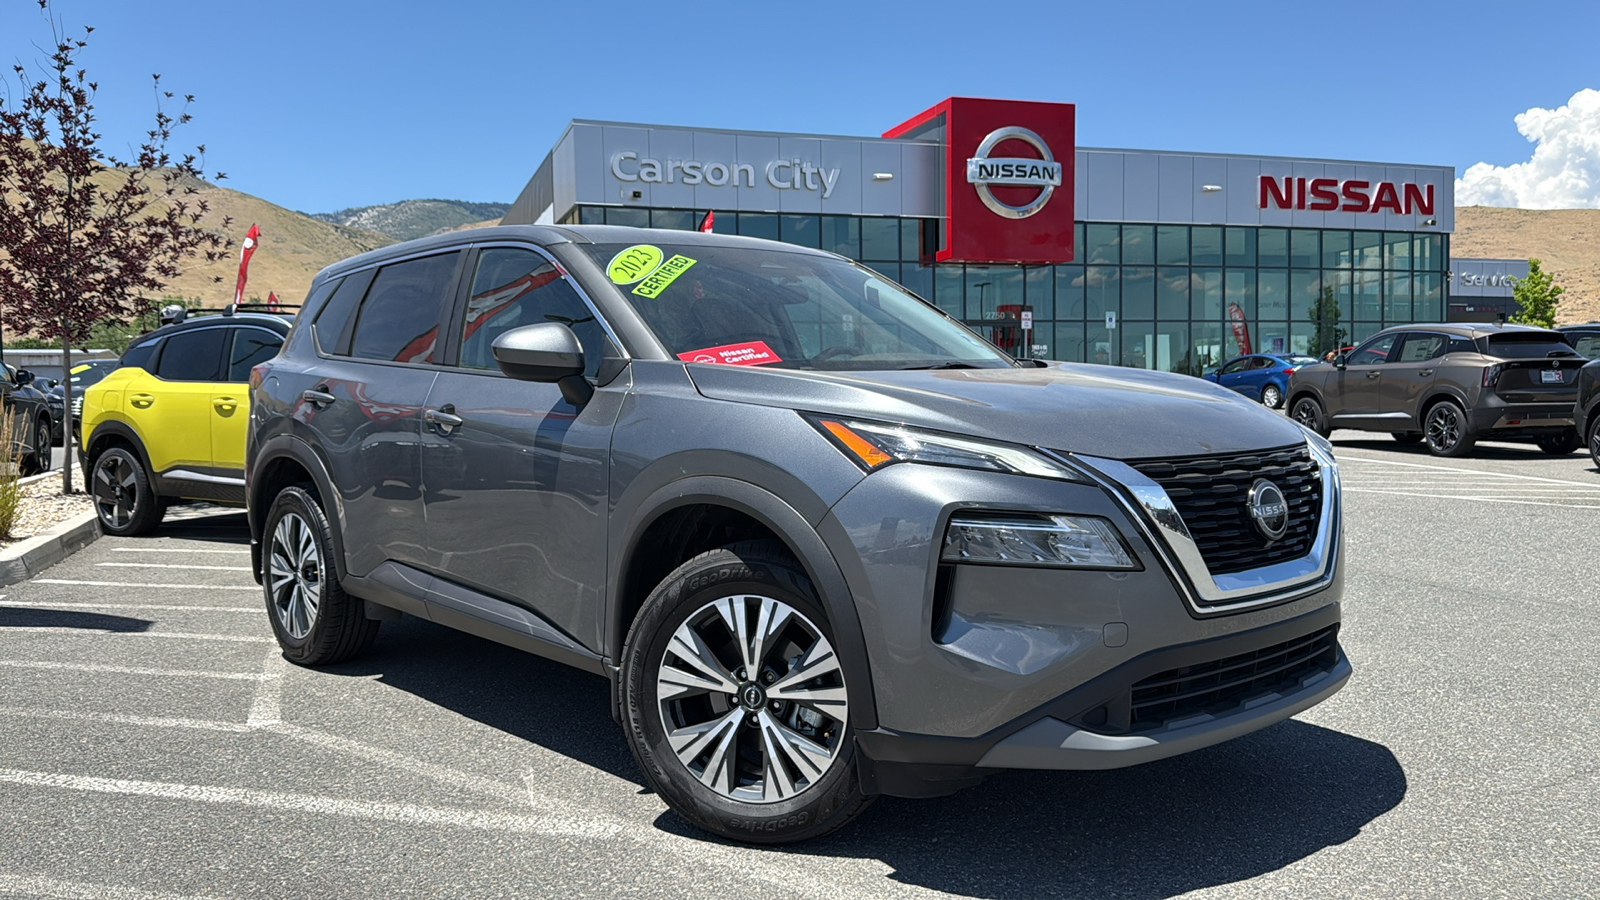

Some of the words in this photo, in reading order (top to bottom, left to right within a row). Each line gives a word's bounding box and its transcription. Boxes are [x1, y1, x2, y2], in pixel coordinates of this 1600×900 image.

[611, 151, 755, 187] Carson
[766, 158, 841, 199] City
[978, 164, 1054, 180] NISSAN
[1259, 176, 1435, 215] NISSAN
[614, 249, 653, 279] 2023
[637, 257, 689, 295] CERTIFIED
[986, 311, 1005, 319] 2750
[719, 348, 755, 358] Nissan
[725, 352, 770, 363] Certified
[689, 566, 765, 591] GeoDrive
[730, 811, 809, 832] GeoDrive
